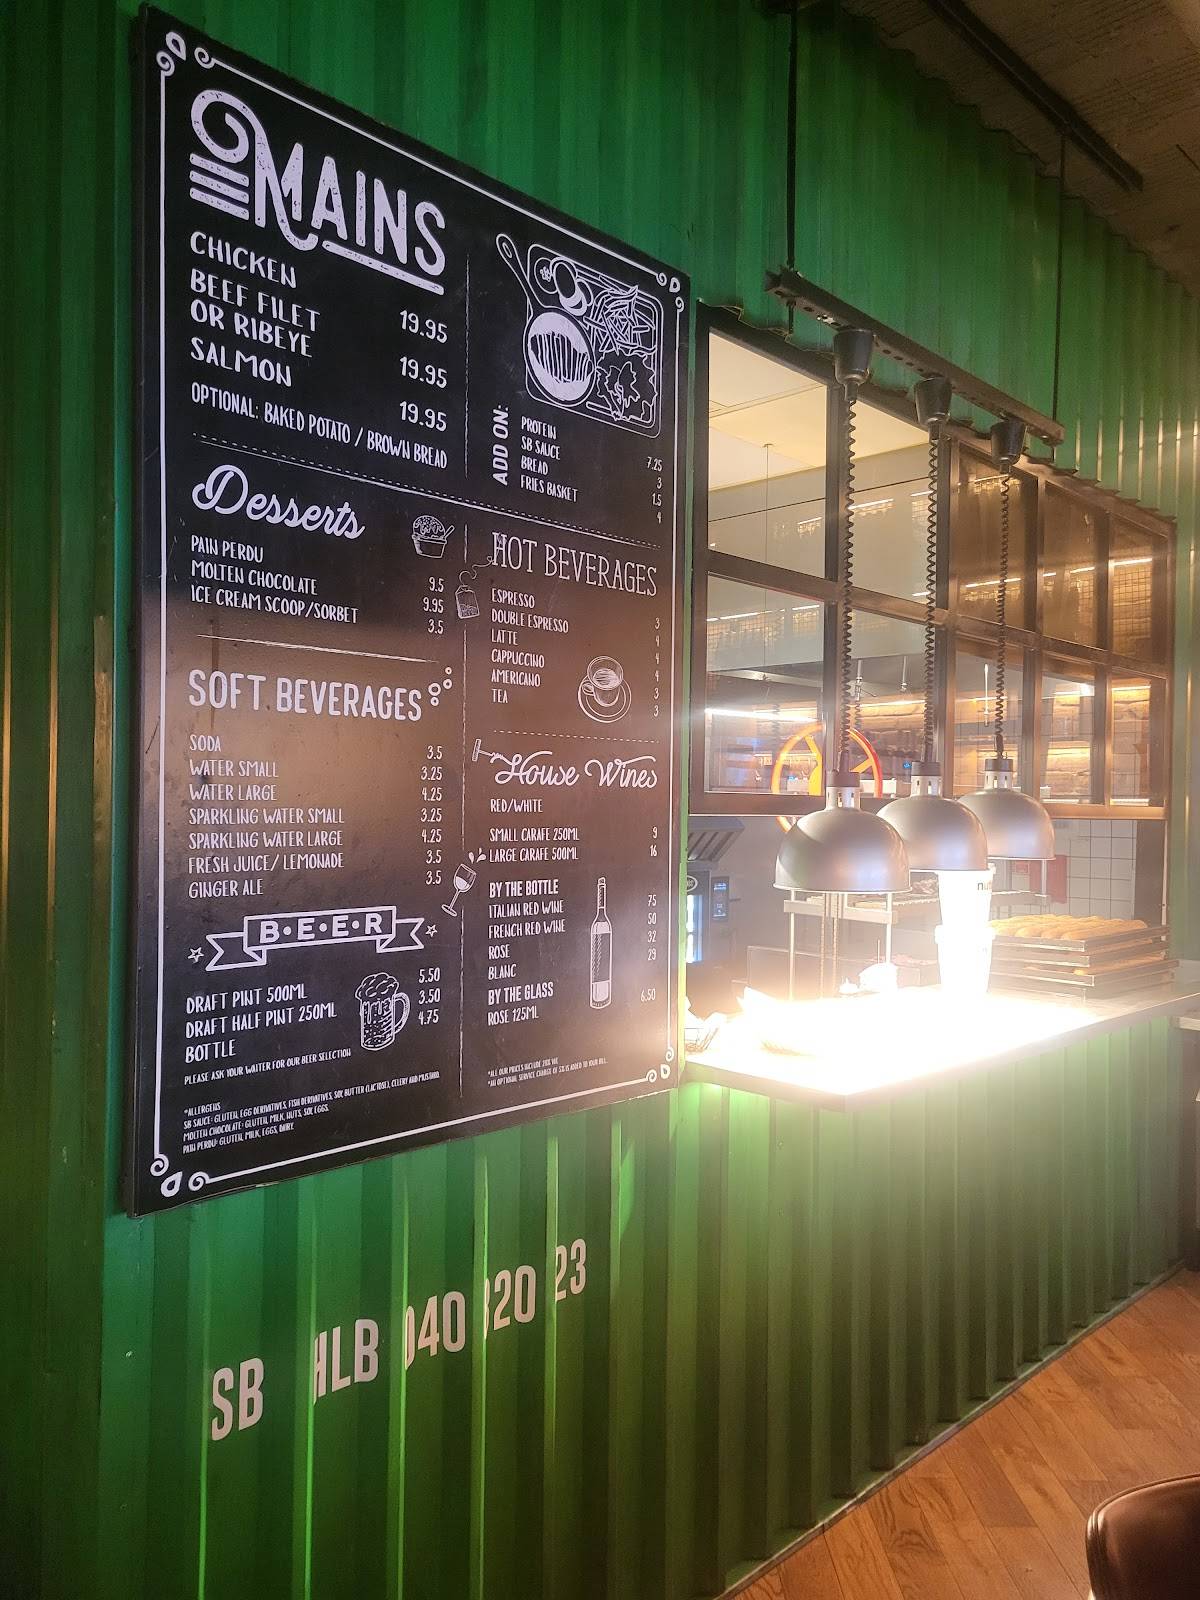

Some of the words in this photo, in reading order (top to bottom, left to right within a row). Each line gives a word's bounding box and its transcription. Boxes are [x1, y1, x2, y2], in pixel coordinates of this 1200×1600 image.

[190, 89, 445, 276] MAINS
[191, 232, 296, 288] CHICKEN
[400, 310, 447, 343] 19.95
[191, 269, 248, 306] BEEF
[258, 292, 320, 331] FILET
[191, 299, 224, 329] OR
[234, 313, 312, 357] RIBEYE
[400, 357, 447, 388] 19.95
[191, 337, 291, 386] SALMON
[400, 401, 446, 431] 19.95
[192, 382, 258, 418] OPTIONAL:
[265, 402, 304, 431] BAKED
[309, 414, 350, 443] POTATO
[355, 428, 363, 446] /
[367, 431, 410, 459] BROWN
[414, 443, 447, 468] BREAD
[493, 405, 508, 439] ON:
[522, 416, 556, 439] PROTEIN
[648, 457, 662, 471] 7.25
[493, 444, 508, 485] ADD
[521, 436, 532, 451] SB
[535, 440, 560, 460] SAUCE
[657, 477, 662, 489] 3
[521, 456, 548, 475] BREAD
[192, 465, 365, 539] Desserts
[521, 475, 544, 493] FRIES
[547, 482, 577, 502] BASKET
[192, 535, 218, 555] PAIN
[223, 541, 263, 562] PERDU
[429, 577, 443, 592] 9.5
[491, 532, 537, 572] HOT
[545, 544, 656, 596] BEVERAGES
[192, 560, 244, 583] MOLTEN
[249, 570, 317, 595] CHOCOLATE
[423, 597, 443, 613] 9.95
[192, 585, 211, 603] ICE
[216, 589, 260, 610] CREAM
[265, 596, 358, 623] SCOOP/SORBET
[428, 619, 443, 634] 3.5
[492, 588, 534, 608] ESPRESSO
[655, 618, 660, 629] 3
[492, 609, 525, 626] DOUBLE
[528, 614, 568, 633] ESPRESSO
[656, 636, 659, 646] 4
[492, 629, 518, 645] LATTE
[656, 653, 659, 664] 4
[492, 649, 544, 668] CAPPUCCINO
[655, 671, 658, 681] 4
[189, 670, 266, 710] SOFT
[277, 678, 421, 721] BEVERAGES
[492, 669, 540, 687] AMERICANO
[654, 688, 659, 699] 3
[492, 689, 507, 703] TEA
[654, 705, 658, 716] 3
[190, 735, 221, 752] SODA
[427, 746, 442, 759] 3.5
[190, 759, 233, 776] WATER
[239, 761, 278, 777] SMALL
[421, 766, 442, 780] 3.25
[489, 751, 579, 786] House
[585, 756, 657, 788] Wines
[190, 784, 233, 800] WATER
[239, 785, 277, 800] LARGE
[422, 787, 442, 801] 4.25
[491, 799, 542, 812] RED/WHITE
[189, 808, 258, 824] SPARKLING
[263, 808, 303, 823] WATER
[308, 808, 344, 823] SMALL
[421, 808, 441, 822] 3.25
[490, 828, 518, 841] SMALL
[522, 828, 550, 841] CARAFE
[553, 828, 579, 840] 250ML
[653, 827, 657, 838] 9
[189, 832, 258, 849] SPARKLING
[263, 831, 303, 847] WATER
[308, 831, 342, 846] LARGE
[422, 829, 441, 842] 4.25
[490, 848, 517, 862] LARGE
[520, 848, 549, 861] CARAFE
[552, 847, 578, 860] 500ML
[650, 845, 657, 856] 16
[189, 854, 229, 873] FRESH
[284, 853, 344, 870] LEMONADE
[426, 850, 441, 863] 3.5
[189, 880, 238, 898] GINGER
[243, 879, 263, 895] ALE
[426, 870, 441, 885] 3.5
[490, 882, 502, 898] BY
[505, 881, 522, 896] THE
[526, 879, 558, 895] BOTTLE
[489, 903, 520, 918] ITALIAN
[523, 902, 539, 915] RED
[542, 900, 563, 914] WINE
[648, 895, 656, 906] 75
[489, 923, 522, 938] FRENCH
[525, 922, 540, 935] RED
[544, 919, 565, 933] WINE
[648, 912, 656, 924] 50
[489, 944, 510, 959] ROSE
[648, 930, 656, 942] 32
[488, 964, 516, 980] BLANC
[648, 948, 656, 960] 29
[187, 993, 228, 1013] DRAFT
[233, 988, 262, 1007] PINT
[267, 984, 307, 1003] 500ML
[419, 968, 440, 983] 5.50
[488, 1009, 509, 1025] ROSE
[513, 1006, 538, 1021] 125ML
[641, 989, 655, 1002] 6.50
[489, 989, 501, 1005] BY
[504, 986, 521, 1003] THE
[525, 982, 553, 1000] GLASS
[186, 1017, 228, 1038] DRAFT
[232, 1012, 261, 1031] HALF
[266, 1008, 294, 1026] PINT
[299, 1002, 337, 1021] 250ML
[419, 988, 440, 1004] 3.50
[186, 1040, 235, 1063] BOTTLE
[419, 1009, 438, 1025] 4.75
[185, 1072, 208, 1085] PLEASE
[211, 1070, 224, 1080] ASK
[227, 1067, 243, 1077] YOUR
[245, 1062, 270, 1074] WAITER
[273, 1060, 285, 1069] FOR
[287, 1057, 300, 1067] OUR
[302, 1054, 317, 1064] BEER
[319, 1048, 351, 1061] SELECTION
[211, 1358, 264, 1440] SB
[313, 1319, 379, 1407] HLB
[405, 1291, 466, 1370] 040
[556, 1238, 587, 1301] 23
